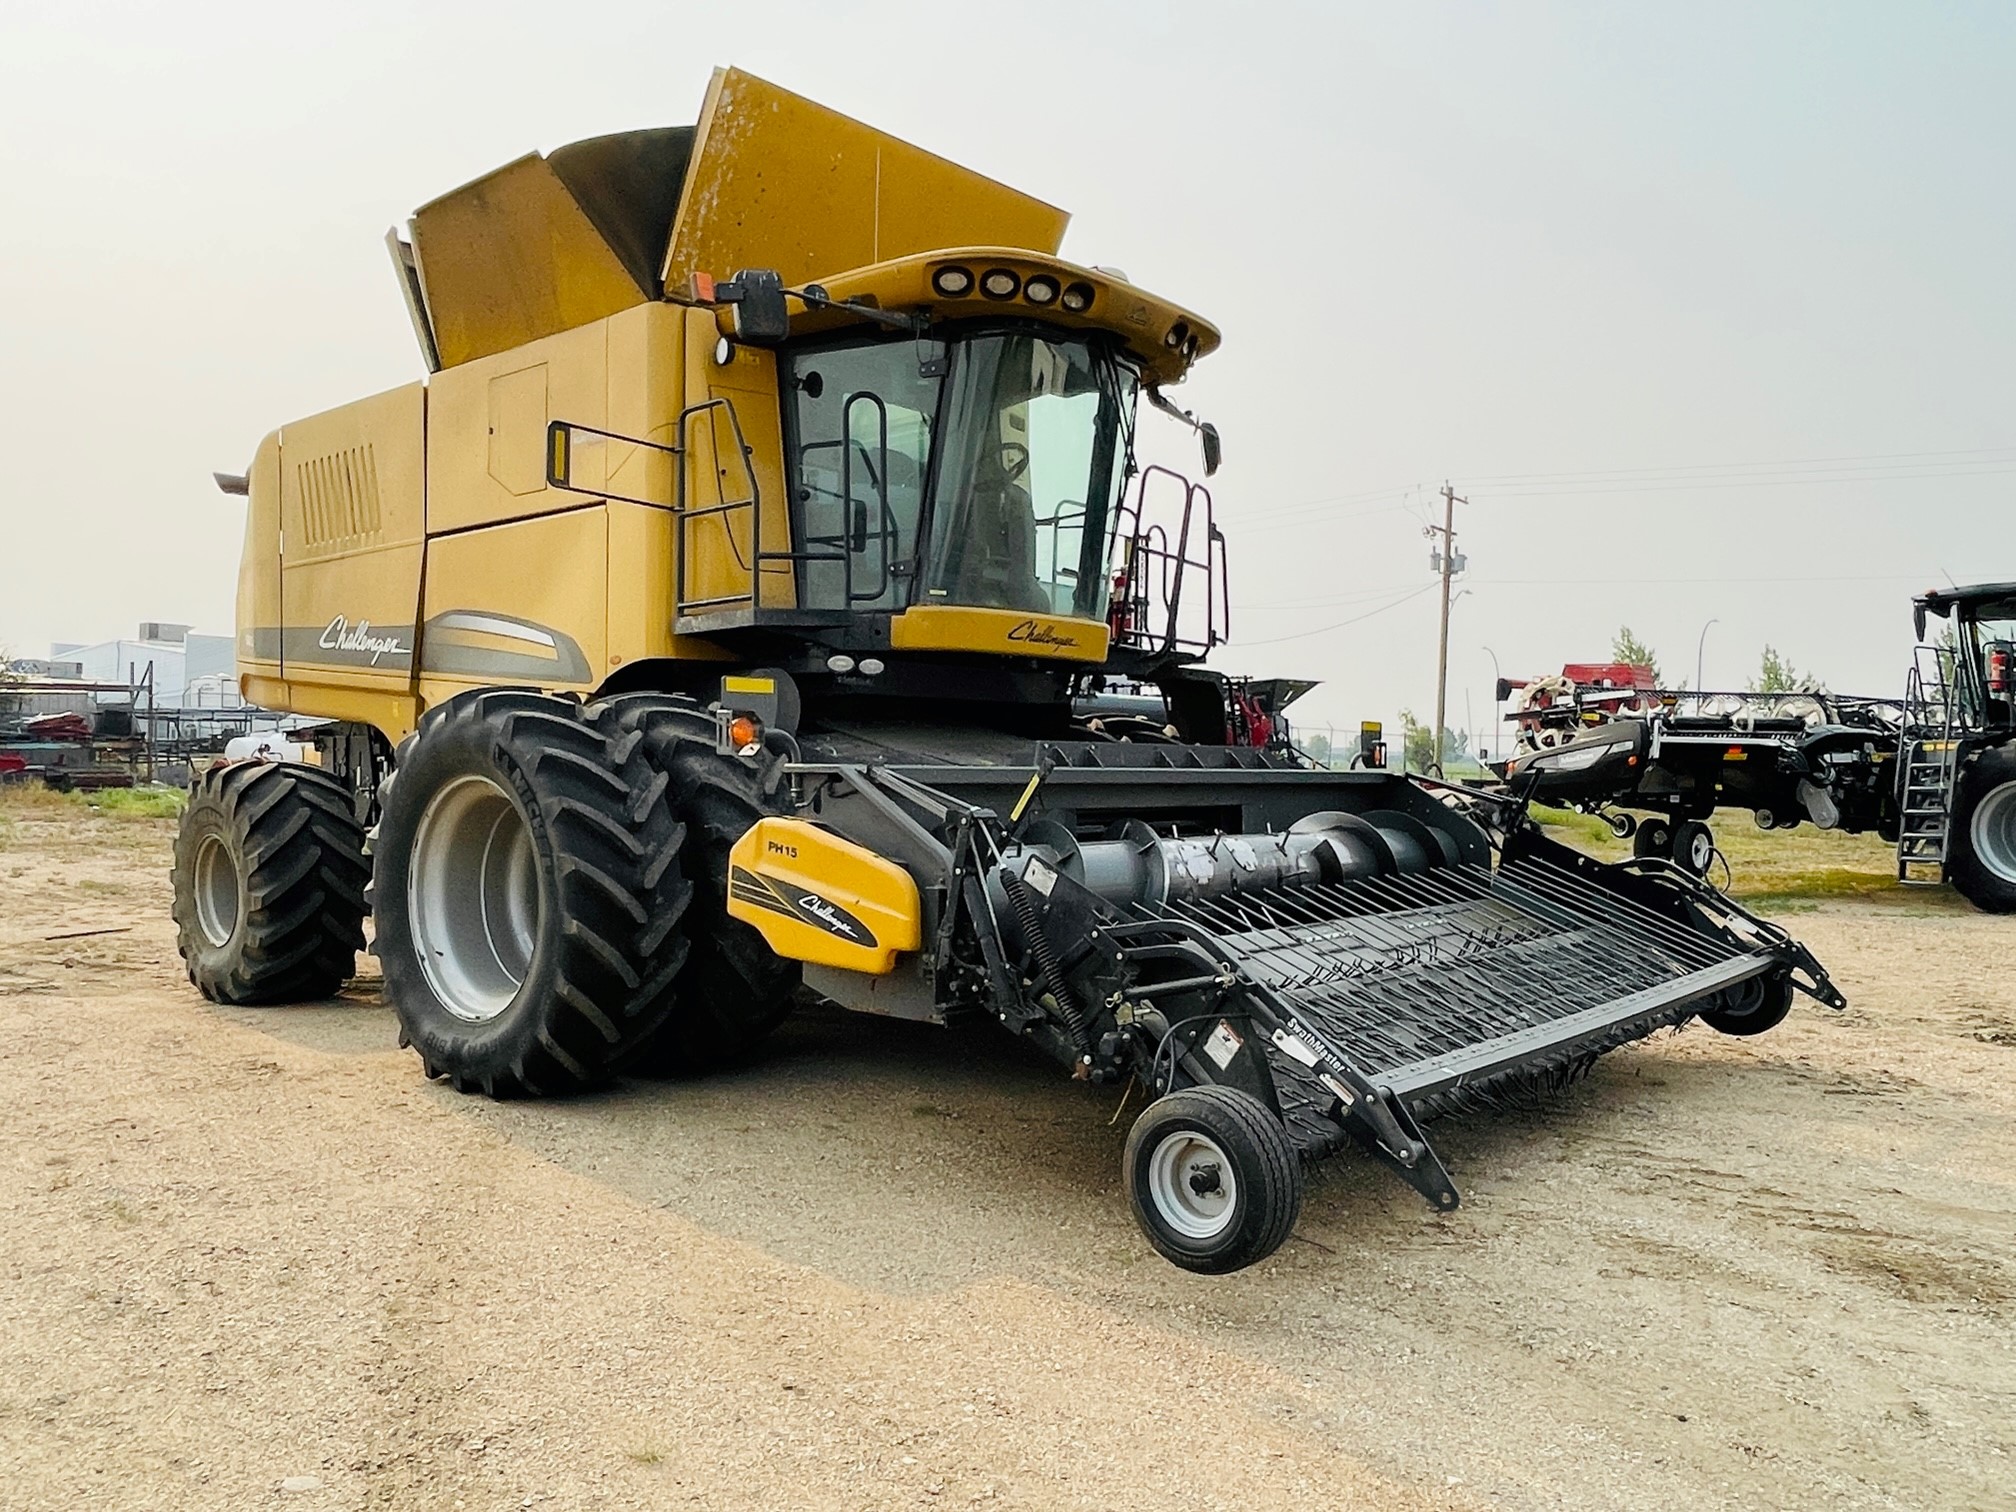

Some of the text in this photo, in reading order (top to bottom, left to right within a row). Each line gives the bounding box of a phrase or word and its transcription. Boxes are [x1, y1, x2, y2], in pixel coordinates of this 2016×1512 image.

[319, 614, 412, 666] Challenger
[1007, 620, 1080, 652] Challenger
[798, 895, 859, 938] Challenger
[1286, 1017, 1347, 1073] SwathMaster
